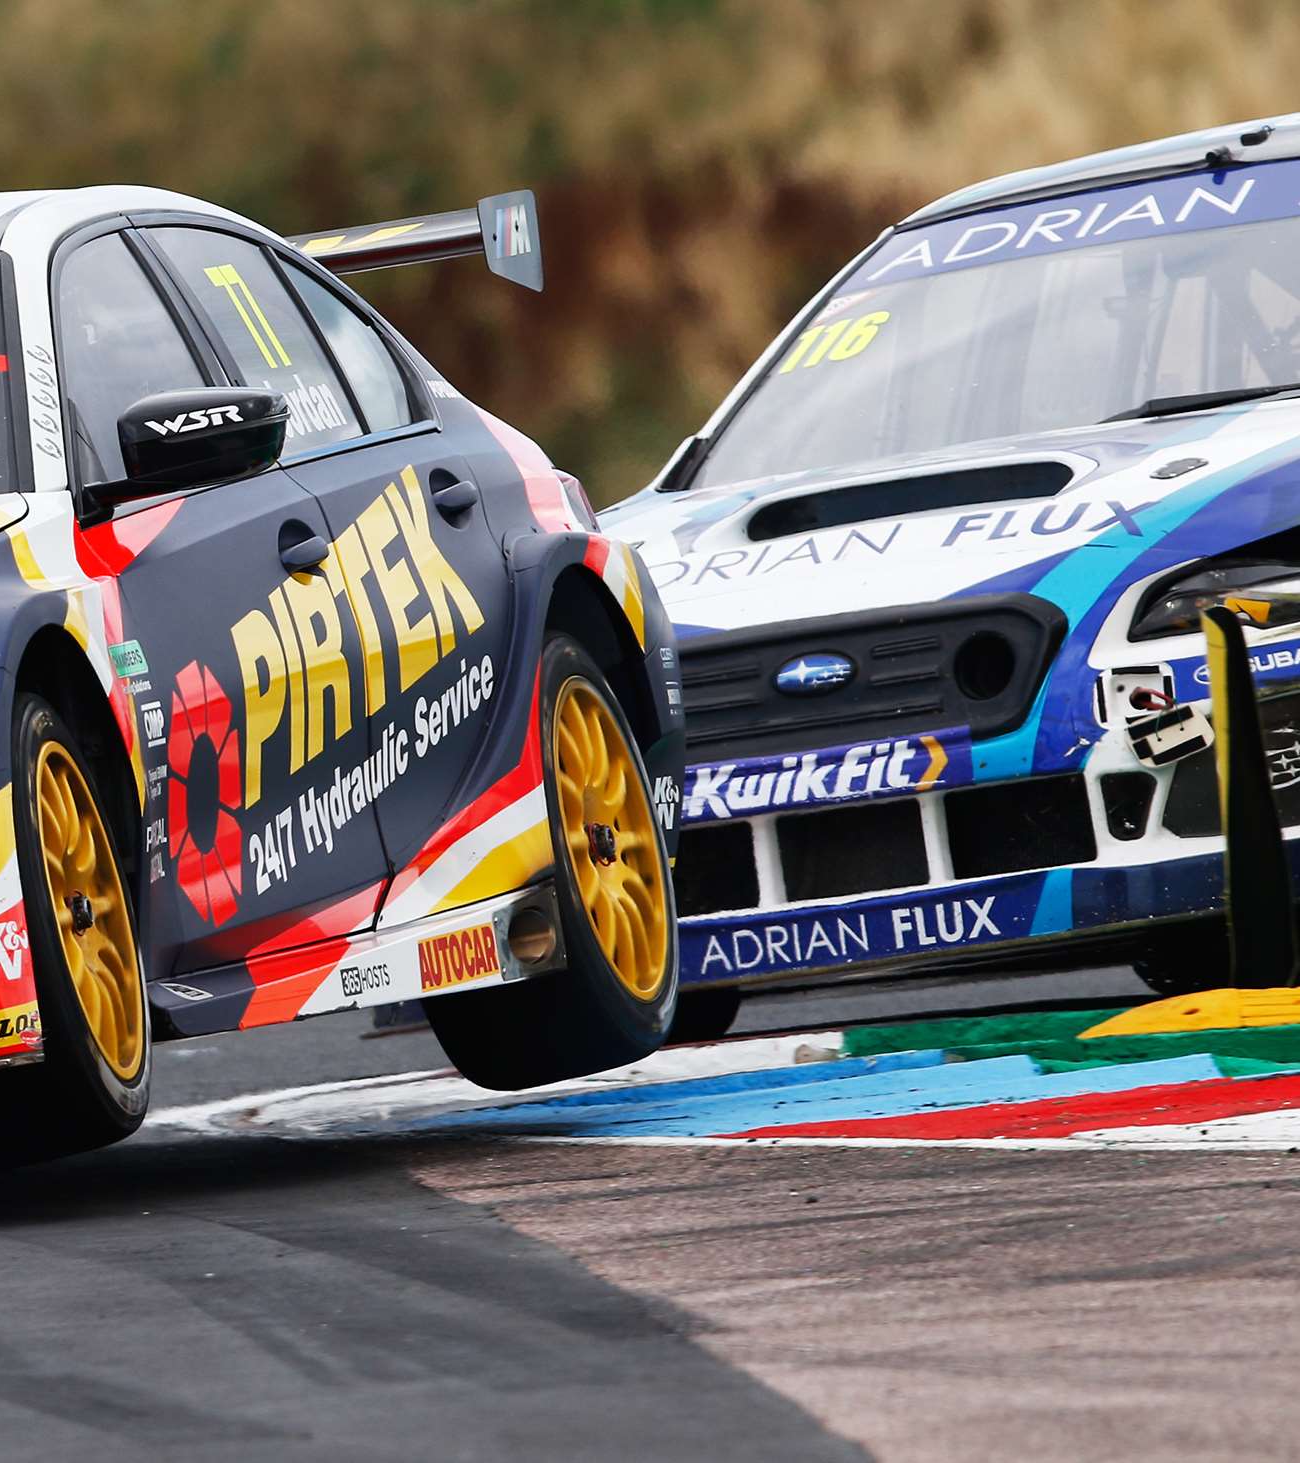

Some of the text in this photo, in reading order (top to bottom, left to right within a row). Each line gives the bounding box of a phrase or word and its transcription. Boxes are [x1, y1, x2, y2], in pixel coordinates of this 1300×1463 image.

[868, 179, 1255, 281] ADRIAN
[203, 263, 292, 369] 77
[778, 310, 891, 375] 116
[144, 404, 244, 438] WSR
[282, 373, 348, 439] ordan
[655, 499, 1160, 589] DRIAN FLUX
[230, 464, 485, 811] PIRTEK
[144, 708, 165, 740] OMP
[248, 655, 494, 896] 24/7 Hydraulic Service
[418, 926, 498, 989] AUTOCAR
[701, 895, 1000, 976] ADRIAN FLUX
[362, 965, 390, 988] HOSTS
